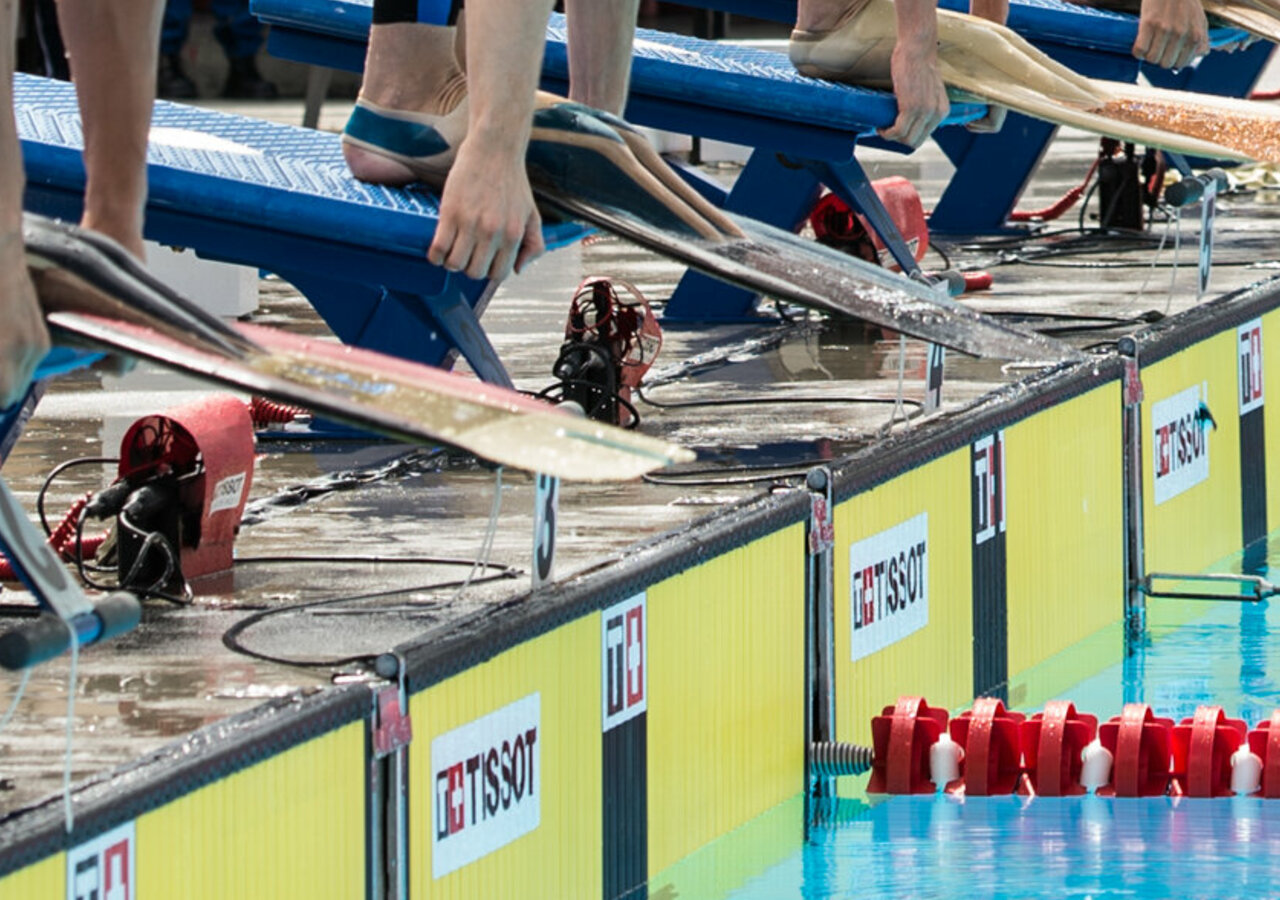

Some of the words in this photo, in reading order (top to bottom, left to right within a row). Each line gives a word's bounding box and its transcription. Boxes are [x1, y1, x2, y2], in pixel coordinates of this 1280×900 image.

[537, 473, 556, 581] 3
[874, 541, 926, 621] TISSOT
[466, 726, 537, 826] TISSOT
